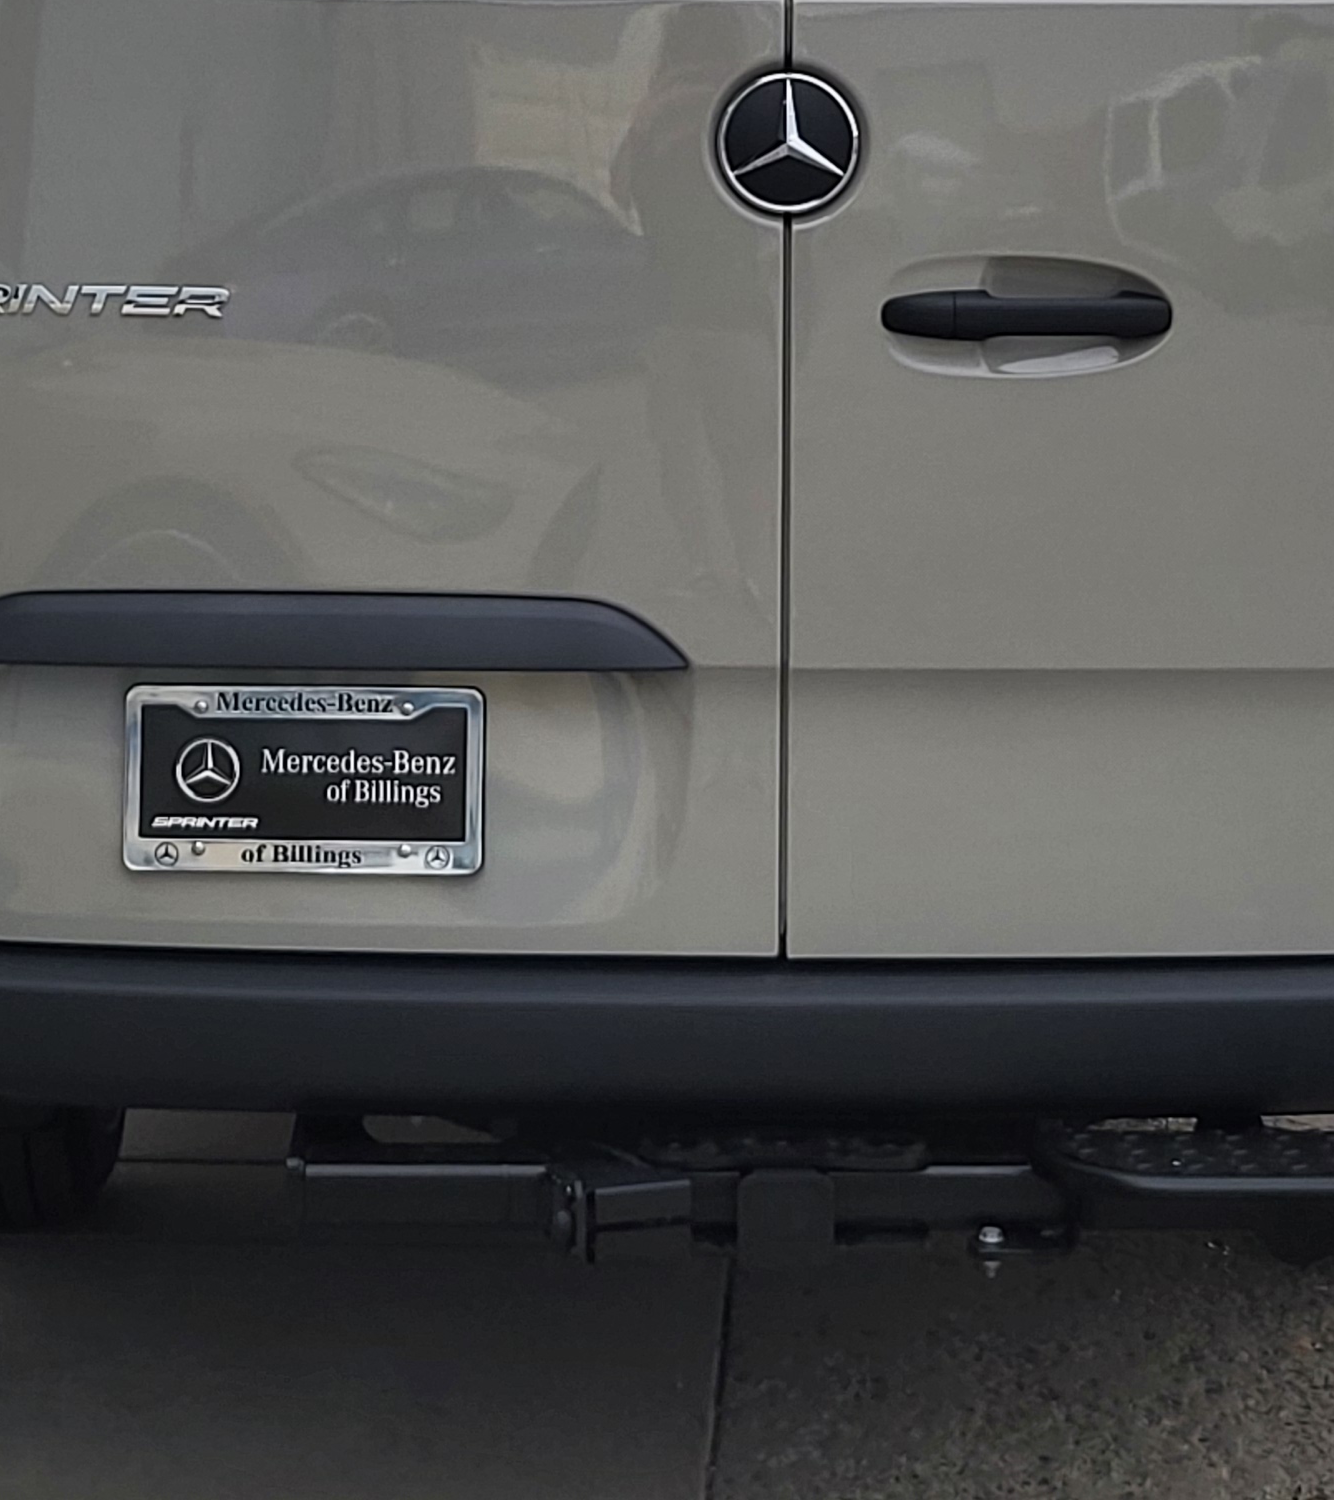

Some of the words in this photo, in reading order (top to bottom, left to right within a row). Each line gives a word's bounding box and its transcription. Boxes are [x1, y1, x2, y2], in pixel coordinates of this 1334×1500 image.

[216, 692, 394, 714] Mercedes-Benz
[261, 748, 456, 775] Mercedes-Benz
[326, 780, 350, 802] of
[354, 780, 442, 808] Billings
[151, 816, 259, 828] SPRINTER
[240, 846, 267, 863] of
[272, 845, 362, 868] Billings
